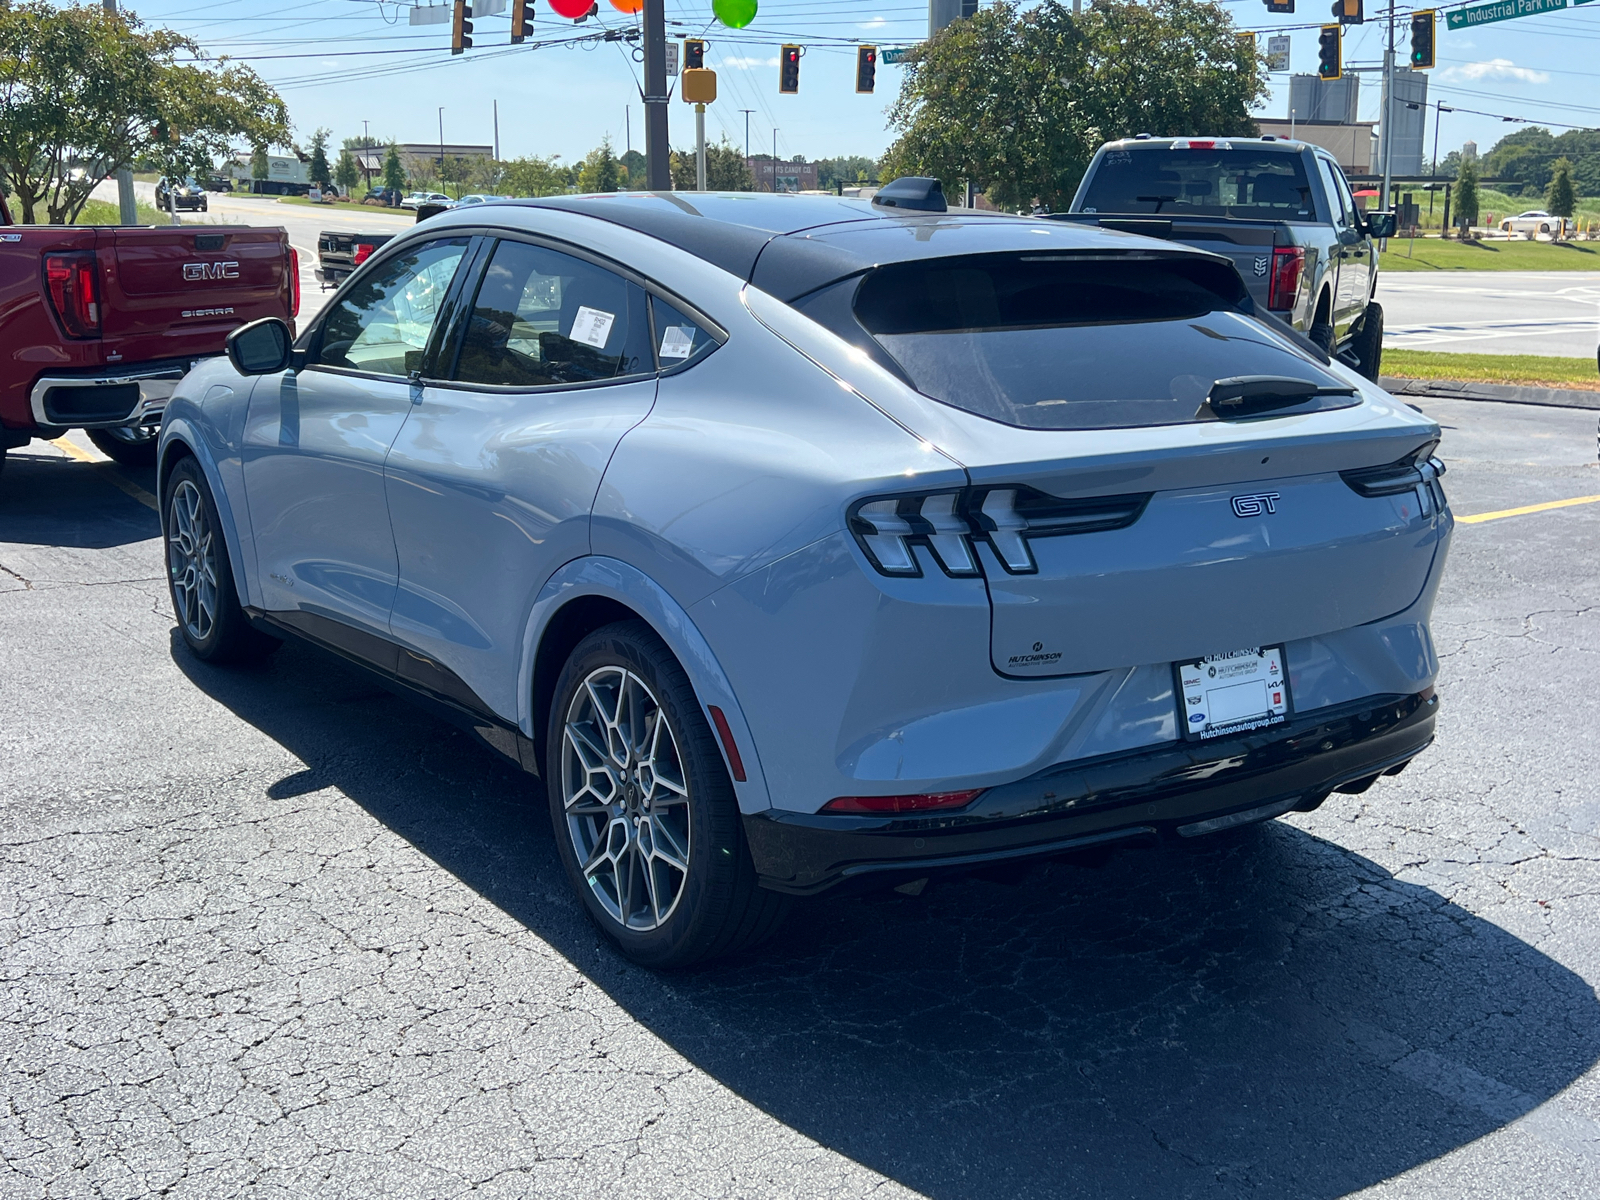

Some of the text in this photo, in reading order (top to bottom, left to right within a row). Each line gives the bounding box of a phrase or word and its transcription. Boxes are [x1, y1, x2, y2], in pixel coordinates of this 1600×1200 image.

[1466, 2, 1515, 23] Industrial
[1518, 0, 1542, 13] Park
[784, 165, 801, 173] CANDY
[183, 262, 239, 280] GMC
[182, 308, 233, 317] SIERRA
[1231, 492, 1280, 517] GT
[1008, 652, 1063, 663] HUTCHINSON
[1214, 647, 1260, 661] HUTCHINSON
[1218, 660, 1258, 675] HUTCHINSON
[1219, 671, 1243, 679] AUTOMOTIVE
[1200, 715, 1285, 740] Hutchinsonautogroup.com
